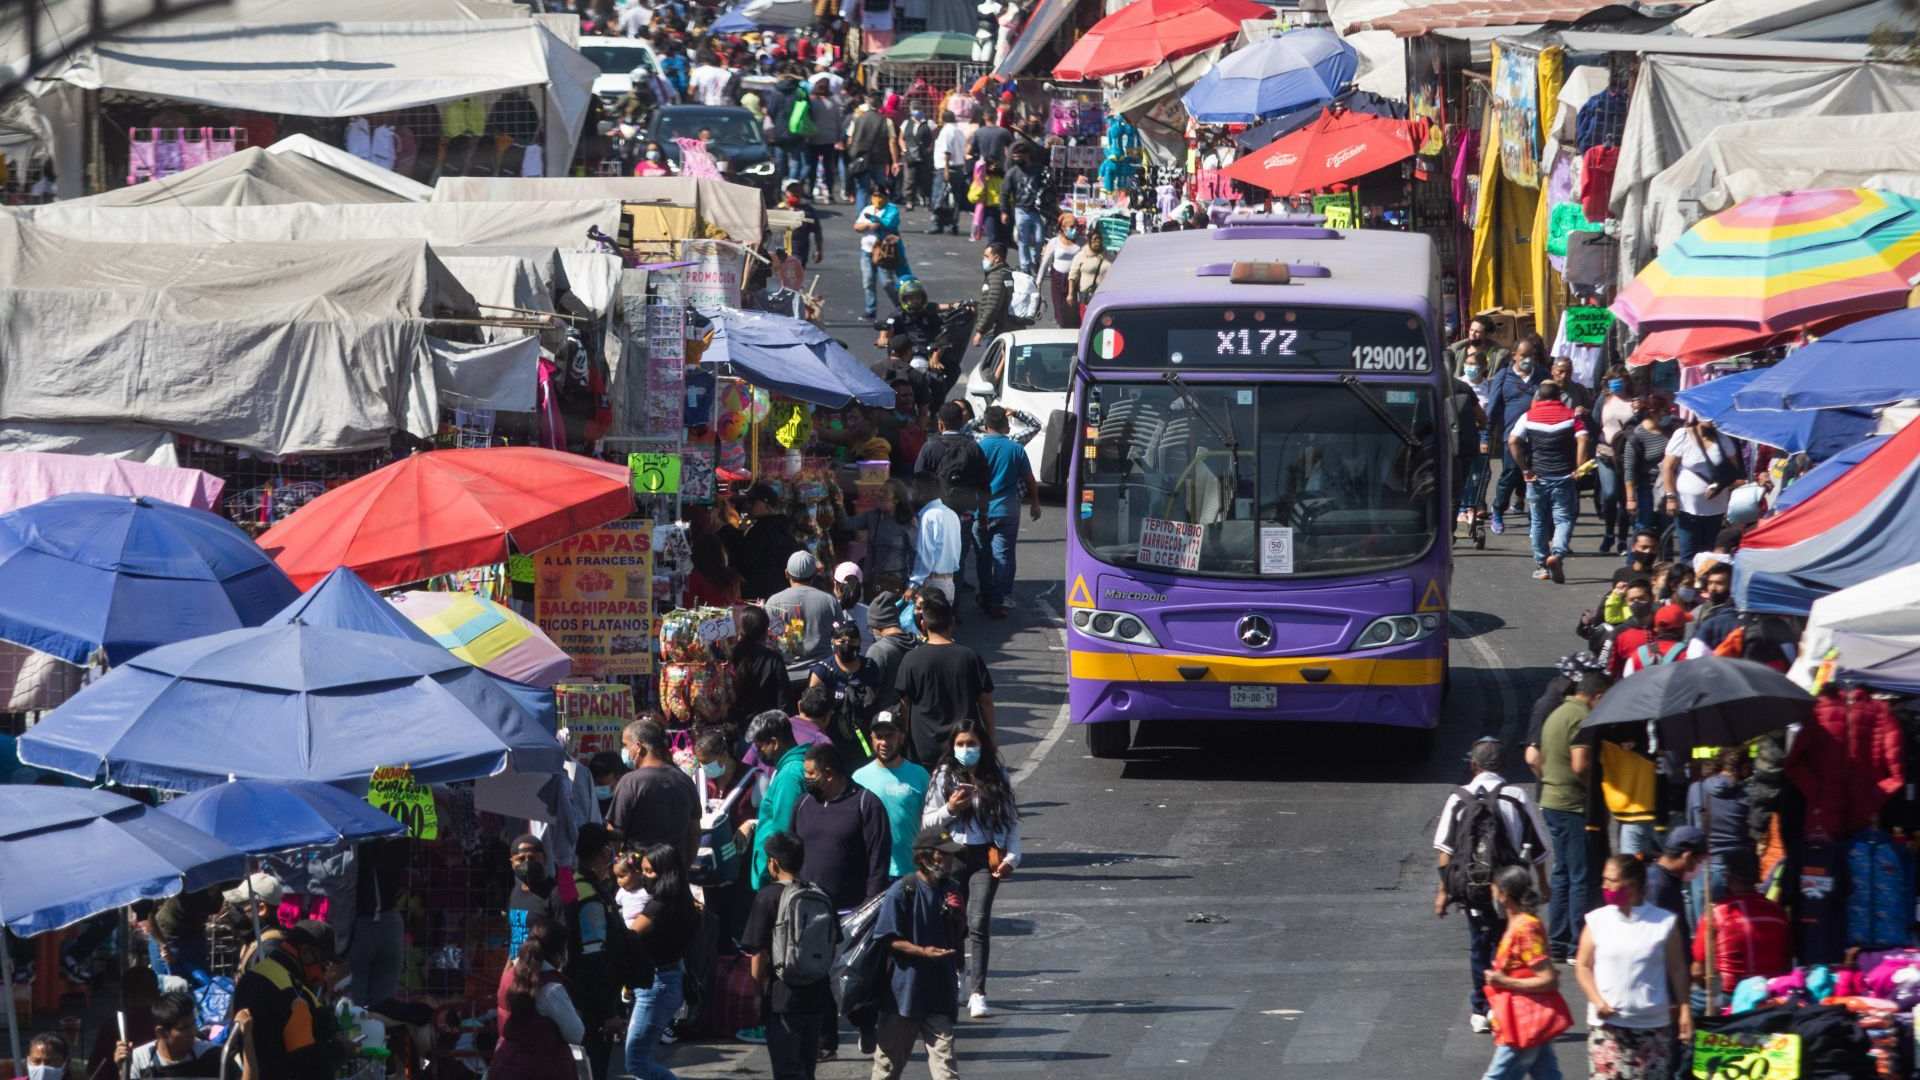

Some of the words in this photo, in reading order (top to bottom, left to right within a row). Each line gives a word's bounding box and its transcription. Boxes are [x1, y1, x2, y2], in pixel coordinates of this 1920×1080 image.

[1351, 345, 1428, 371] 1290012
[642, 462, 665, 491] 5
[1145, 518, 1174, 533] TEPITO
[1175, 522, 1202, 538] RUBIO
[561, 532, 651, 553] PAPAS
[1142, 531, 1182, 551] MARRUECOS
[544, 556, 553, 566] A
[556, 556, 572, 566] LA
[576, 555, 645, 566] FRANCESA
[1154, 551, 1197, 569] OCEANIA
[1104, 588, 1168, 602] Marcopolo
[540, 601, 648, 615] SALCHIPAPAS
[539, 618, 578, 631] RICOS
[582, 618, 650, 631] PLATANOS
[556, 690, 634, 720] TEPACHE
